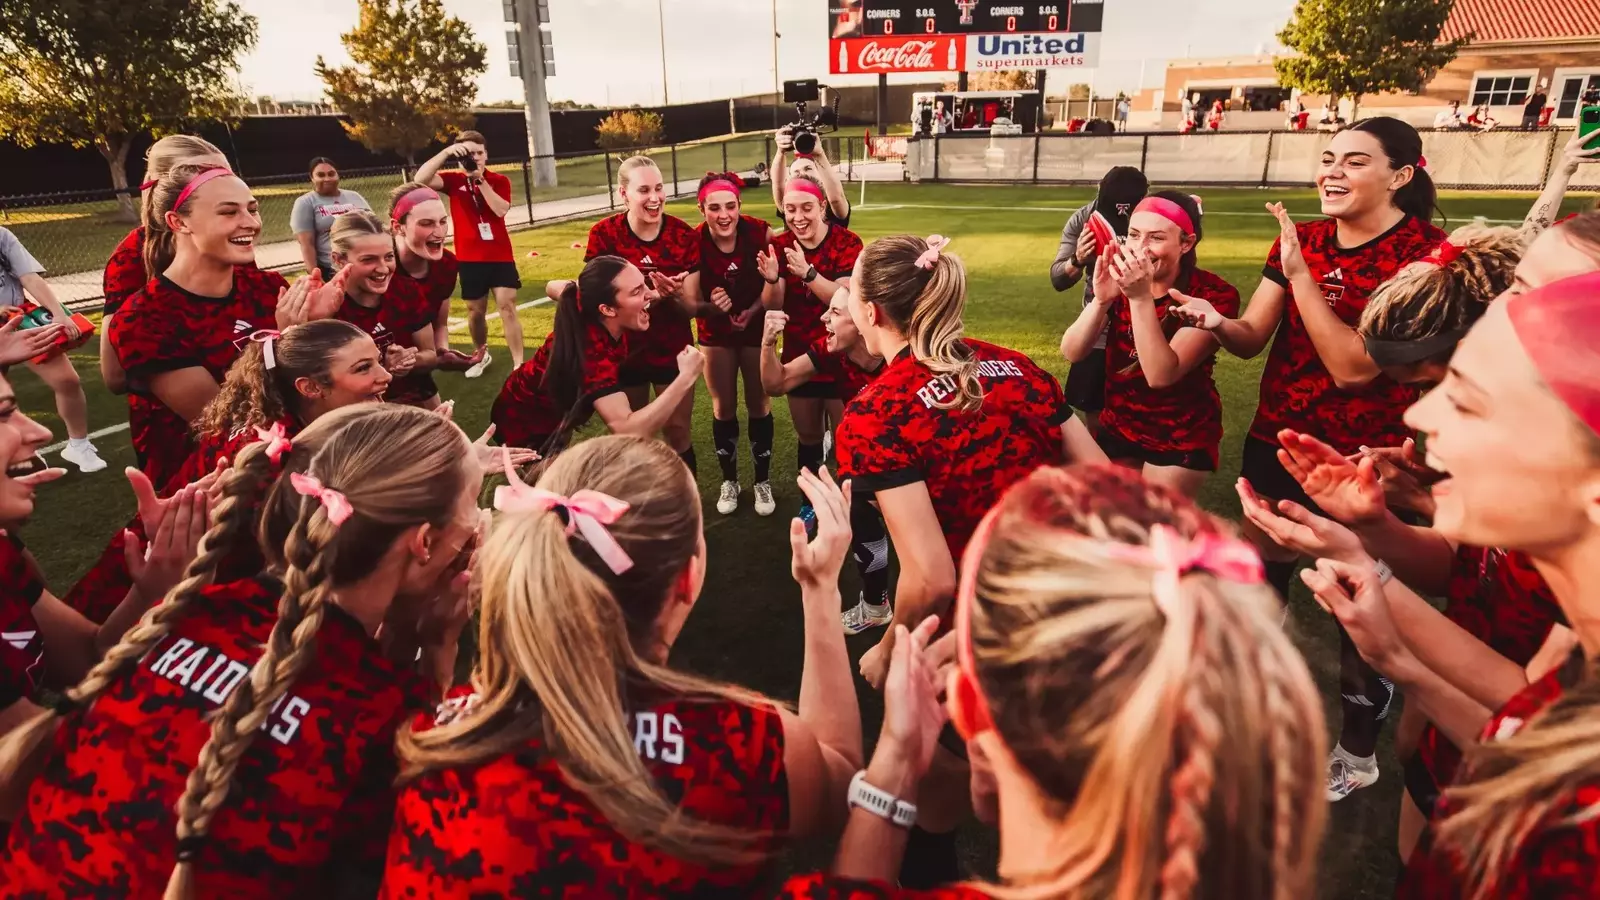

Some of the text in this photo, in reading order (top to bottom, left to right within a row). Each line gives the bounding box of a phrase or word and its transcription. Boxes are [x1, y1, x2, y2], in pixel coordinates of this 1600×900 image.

[866, 9, 901, 19] CORNERS
[915, 8, 936, 18] S.O.G.
[990, 6, 1024, 17] CORNERS
[1038, 5, 1059, 15] S.O.G.
[883, 19, 893, 34] 0
[925, 18, 935, 33] 0
[1006, 16, 1016, 31] 0
[1048, 15, 1058, 30] 0
[977, 33, 1085, 55] United
[976, 55, 1084, 69] supermarkets
[150, 637, 311, 745] RAIDS
